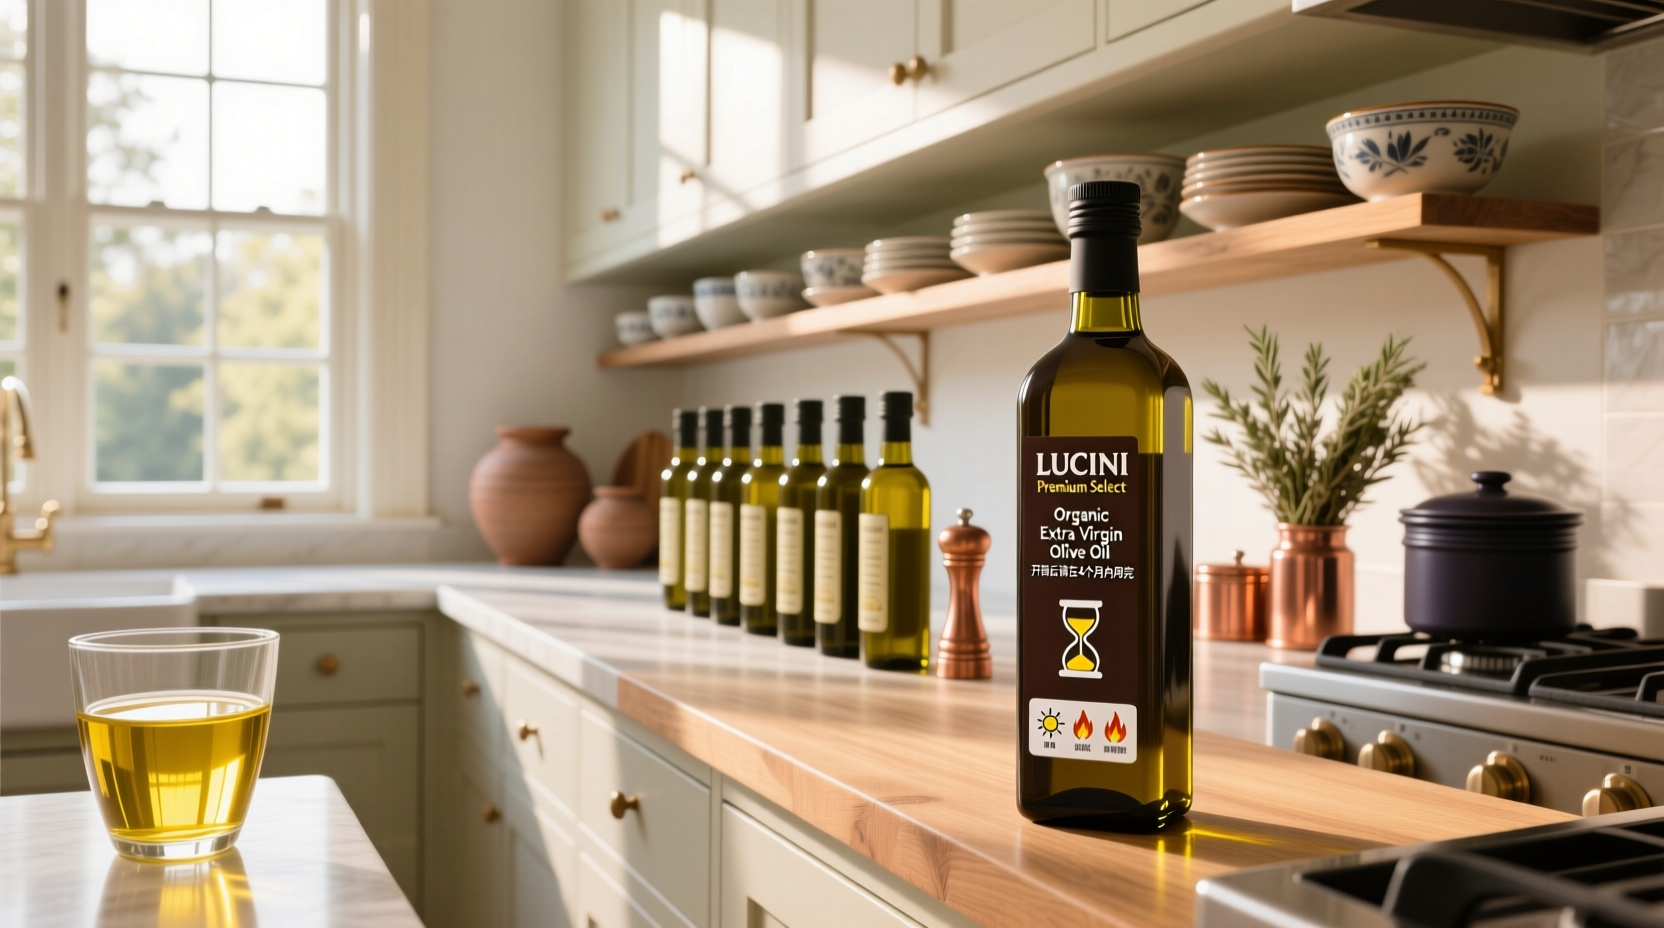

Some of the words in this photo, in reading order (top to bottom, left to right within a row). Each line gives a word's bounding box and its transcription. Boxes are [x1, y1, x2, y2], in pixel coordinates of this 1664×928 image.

[1036, 452, 1128, 476] LUCINI
[1037, 480, 1087, 493] Premium
[1090, 479, 1127, 493] Select
[1054, 507, 1109, 526] Organic
[1040, 526, 1075, 541] Extra
[1079, 526, 1123, 545] Virgin
[1050, 543, 1086, 559] Olive
[1090, 544, 1110, 560] Oil
